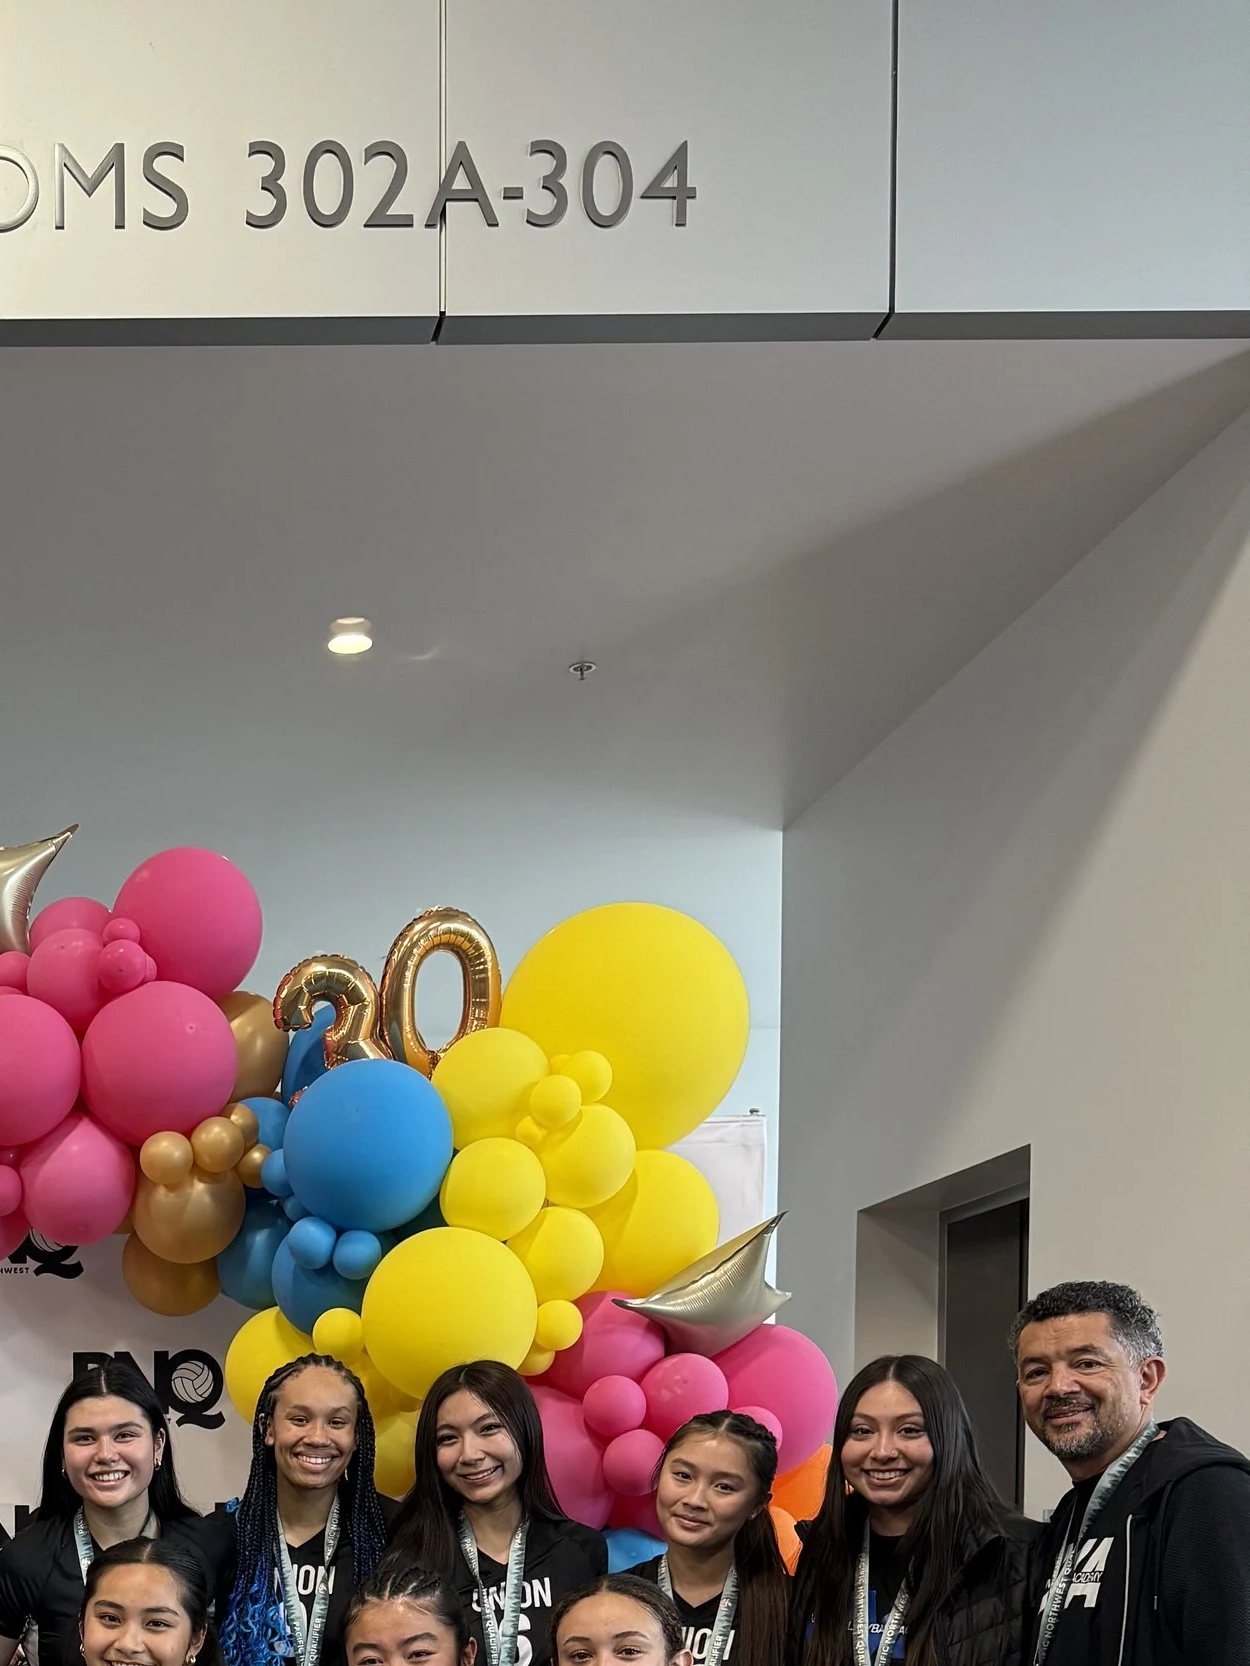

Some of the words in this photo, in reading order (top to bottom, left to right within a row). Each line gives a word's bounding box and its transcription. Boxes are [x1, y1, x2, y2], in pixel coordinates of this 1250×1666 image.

[246, 138, 698, 230] 302A-304
[1044, 1577, 1068, 1638] NORTHWEST
[309, 1617, 322, 1661] QUALIFIER
[485, 1618, 500, 1666] QUALIFIER
